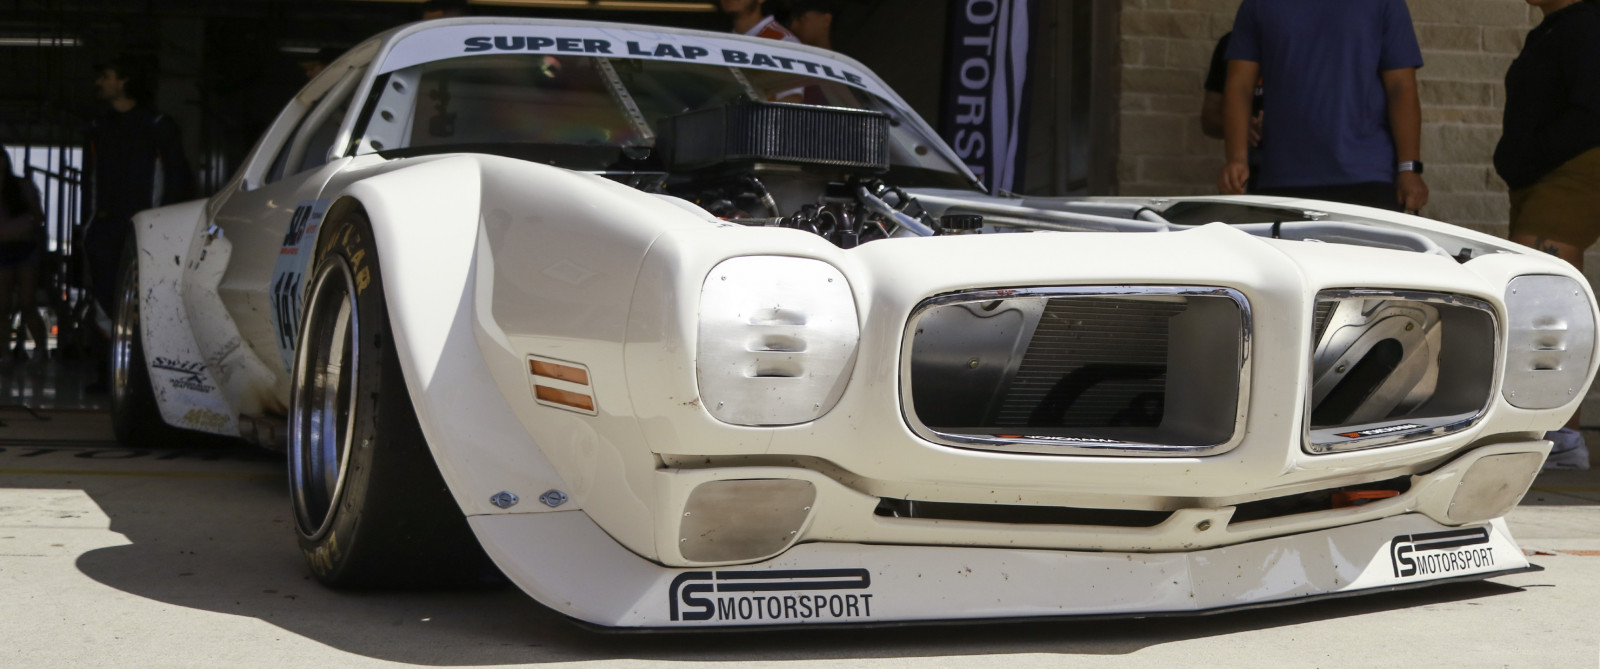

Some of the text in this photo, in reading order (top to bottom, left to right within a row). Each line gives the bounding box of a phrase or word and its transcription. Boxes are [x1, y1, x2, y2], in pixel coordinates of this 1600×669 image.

[464, 36, 867, 88] SUPER LAP BATTLE
[1416, 547, 1495, 575] MOTORSPORT
[718, 594, 873, 620] MOTORSPORT
